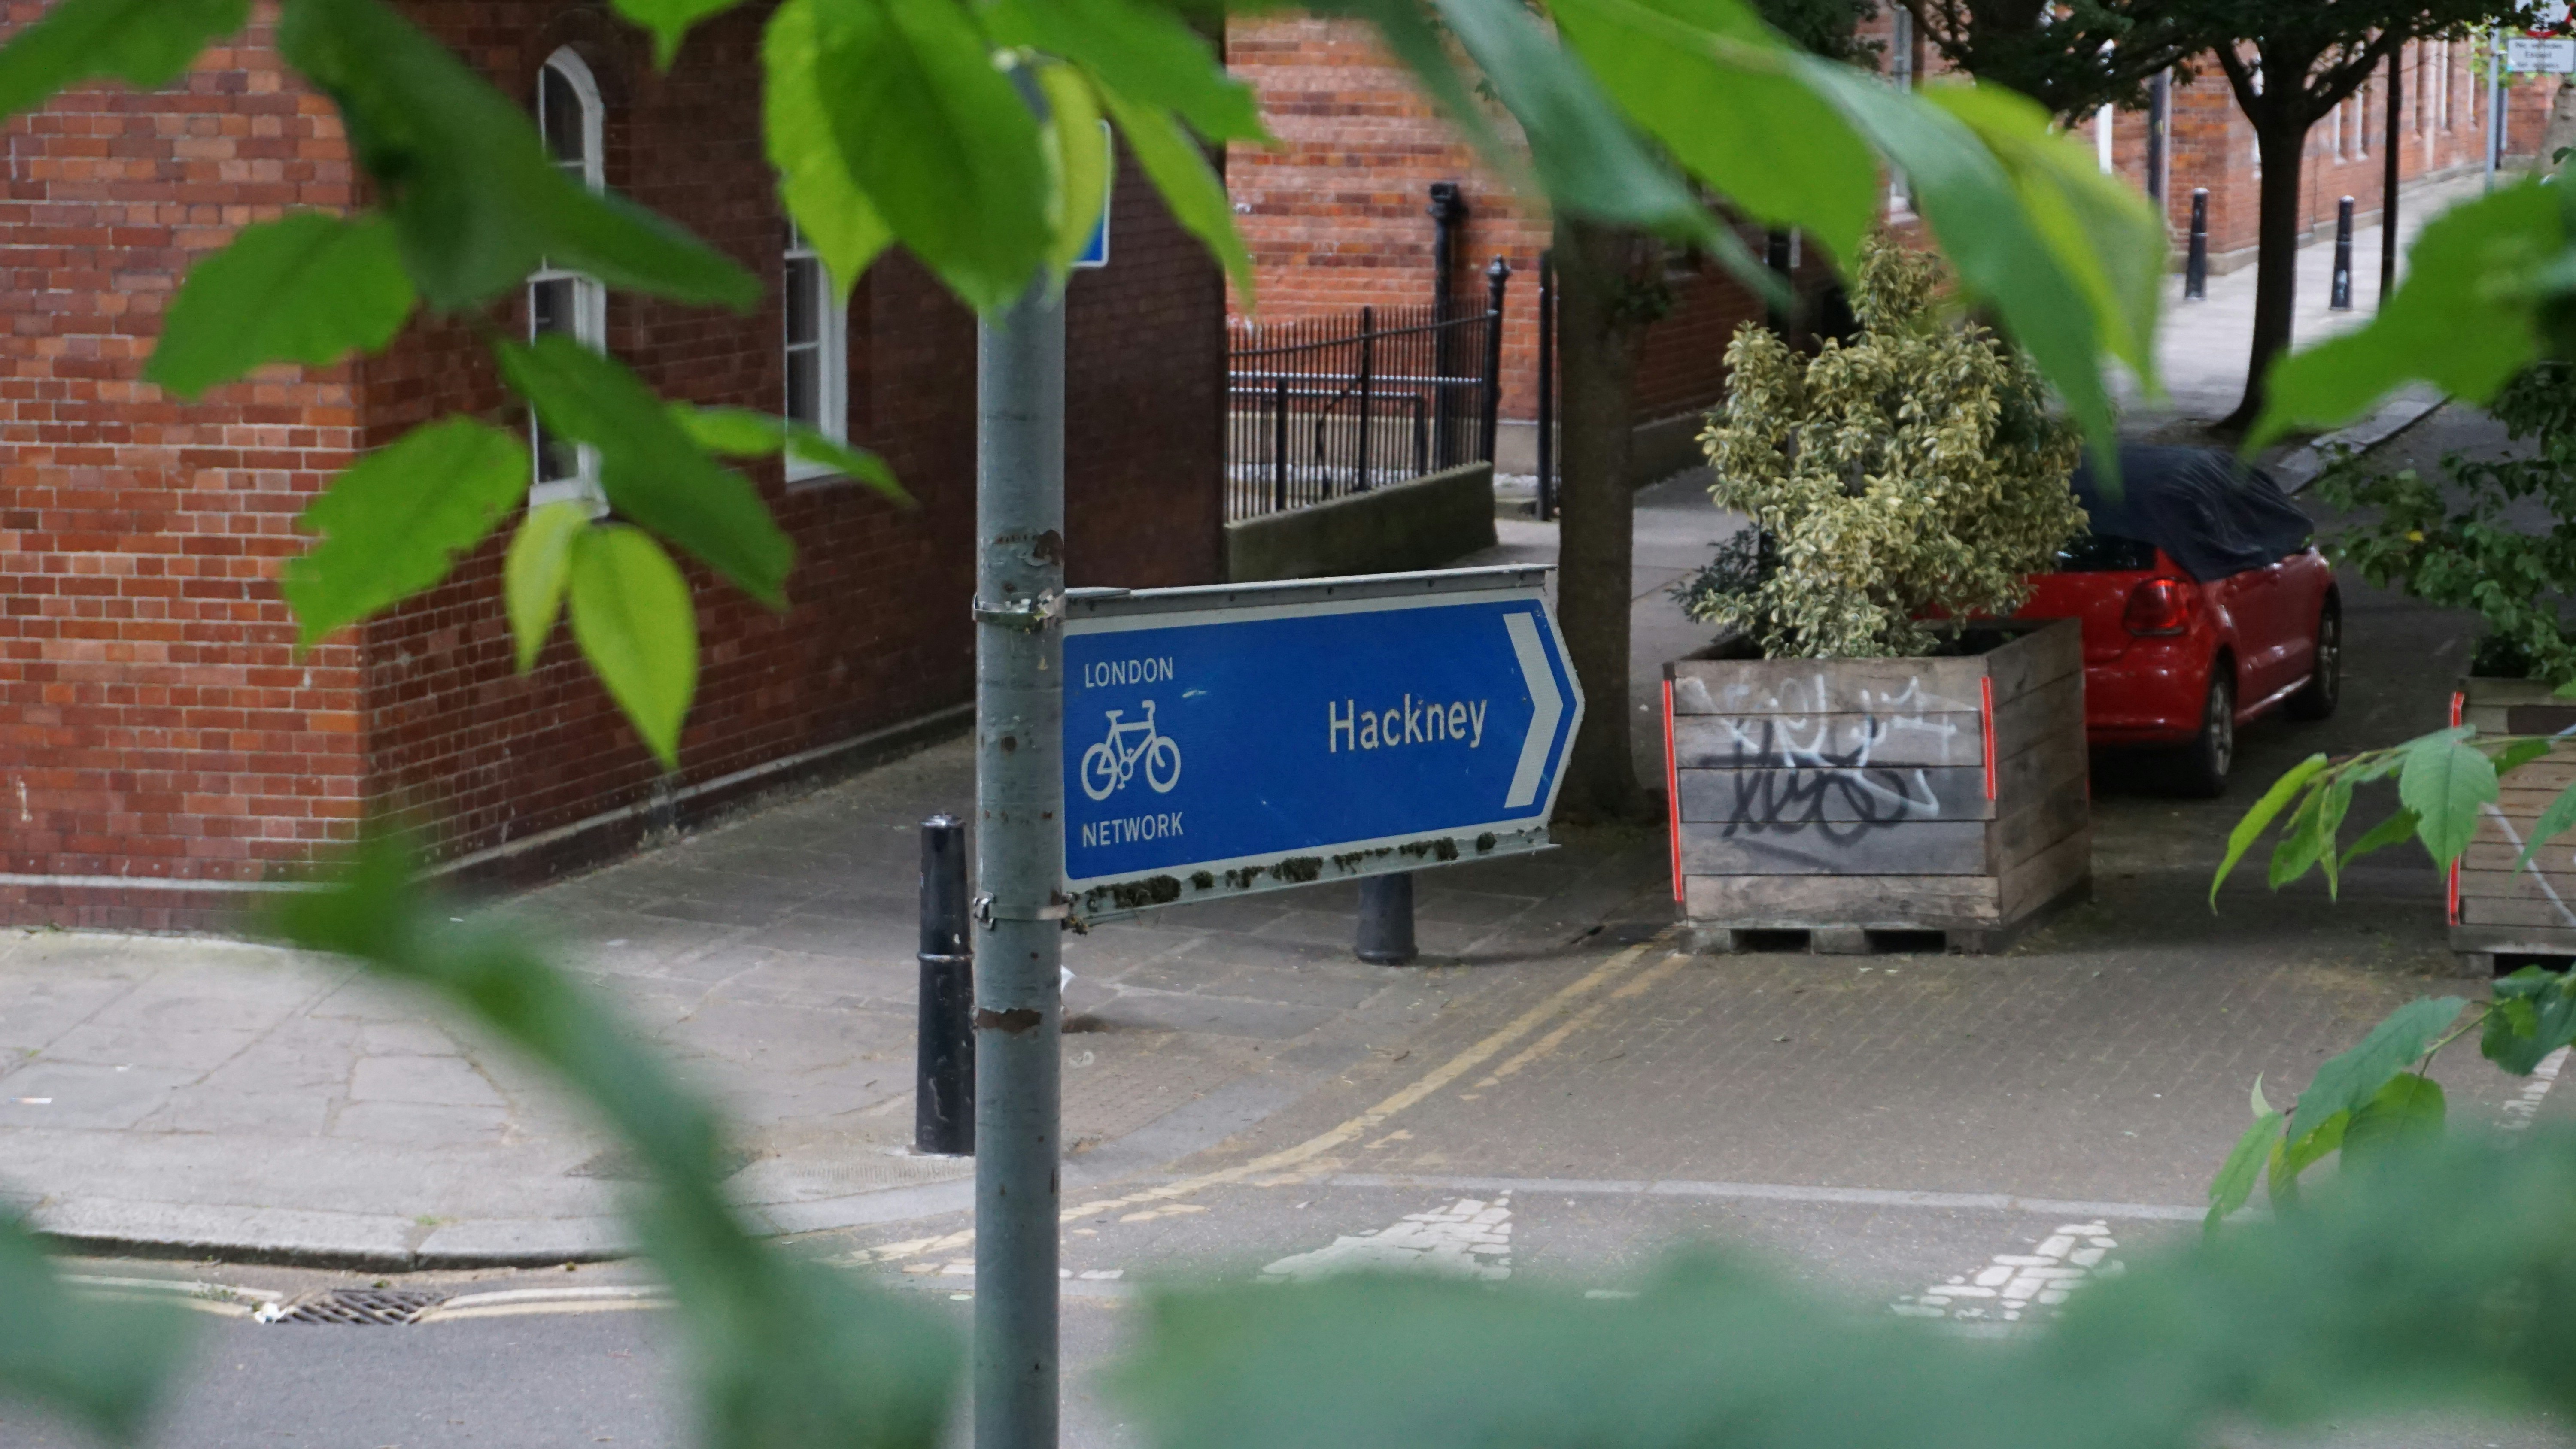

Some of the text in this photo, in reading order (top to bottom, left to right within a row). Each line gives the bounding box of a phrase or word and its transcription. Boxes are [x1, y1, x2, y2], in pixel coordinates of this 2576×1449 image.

[1085, 657, 1173, 688] LONDON
[1330, 693, 1487, 752] Hackney
[1082, 812, 1183, 847] NETWORK
